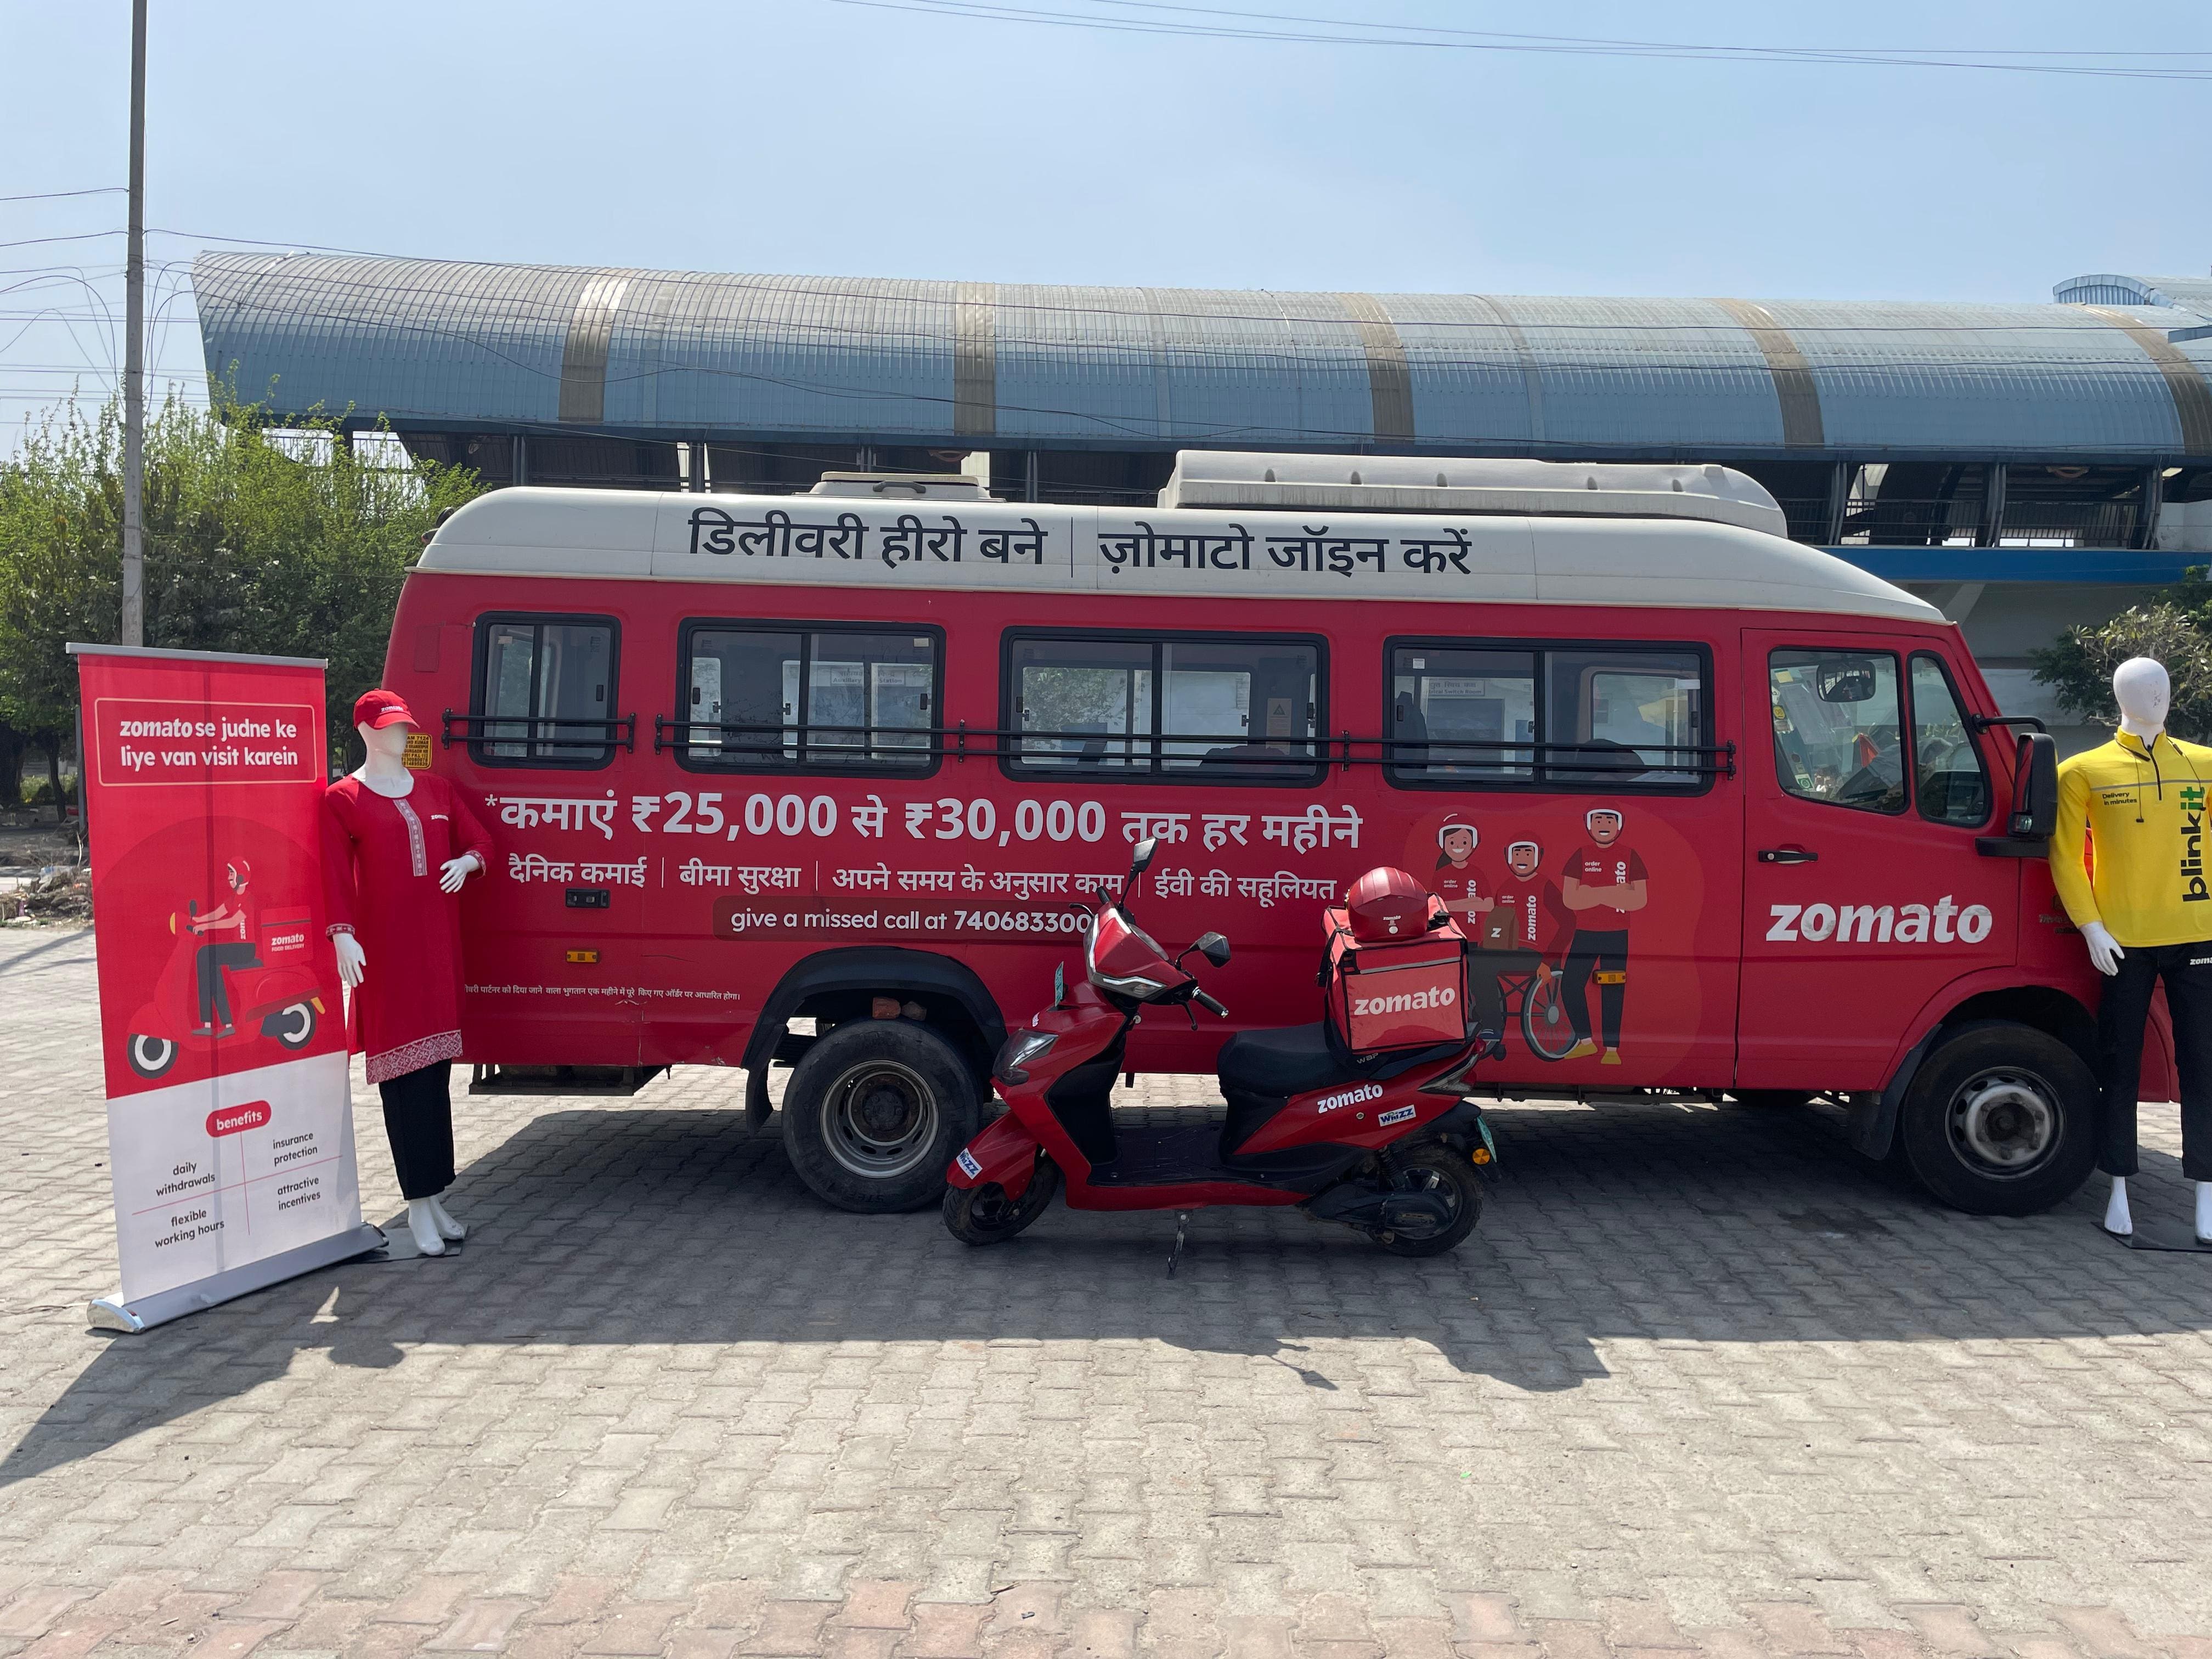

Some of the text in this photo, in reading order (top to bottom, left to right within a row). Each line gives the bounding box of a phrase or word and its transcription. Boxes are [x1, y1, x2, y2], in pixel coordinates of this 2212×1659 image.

[687, 507, 1048, 569] डिलीवरी हीरो बने
[1097, 521, 1472, 578] ज़ोमाटो जॉइन करें
[120, 716, 297, 742] zomato se judne ke
[121, 744, 298, 772] liye van visit karein
[631, 791, 837, 841] ₹25,000
[851, 794, 888, 838] से
[905, 798, 1105, 847] ₹30,000
[1121, 812, 1191, 844] तक
[1201, 814, 1251, 853] हर
[1261, 804, 1363, 855] महीने
[2180, 786, 2210, 902] blinkit
[508, 853, 647, 888] दैनिक कमाई
[679, 857, 802, 895] बीमा सुरक्षा
[832, 862, 1125, 900] अपने समय के अनुसार काम
[1154, 867, 1338, 908] ईवी की सहूलियत
[731, 907, 1092, 933] give a missed call at 740683300
[1526, 895, 1537, 941] zomato
[1766, 894, 1993, 944] zomato
[271, 933, 304, 945] zomato
[1354, 986, 1455, 1015] zomato
[1317, 1084, 1384, 1114] zomato
[216, 1110, 263, 1131] benefits
[273, 1131, 314, 1149] insurance
[173, 1162, 197, 1176] daily
[273, 1146, 318, 1167] protection
[156, 1173, 216, 1197] withdrawals
[277, 1176, 319, 1195] attractive
[278, 1190, 321, 1211] incentives
[170, 1209, 207, 1227] flexible
[155, 1220, 225, 1248] working hours
